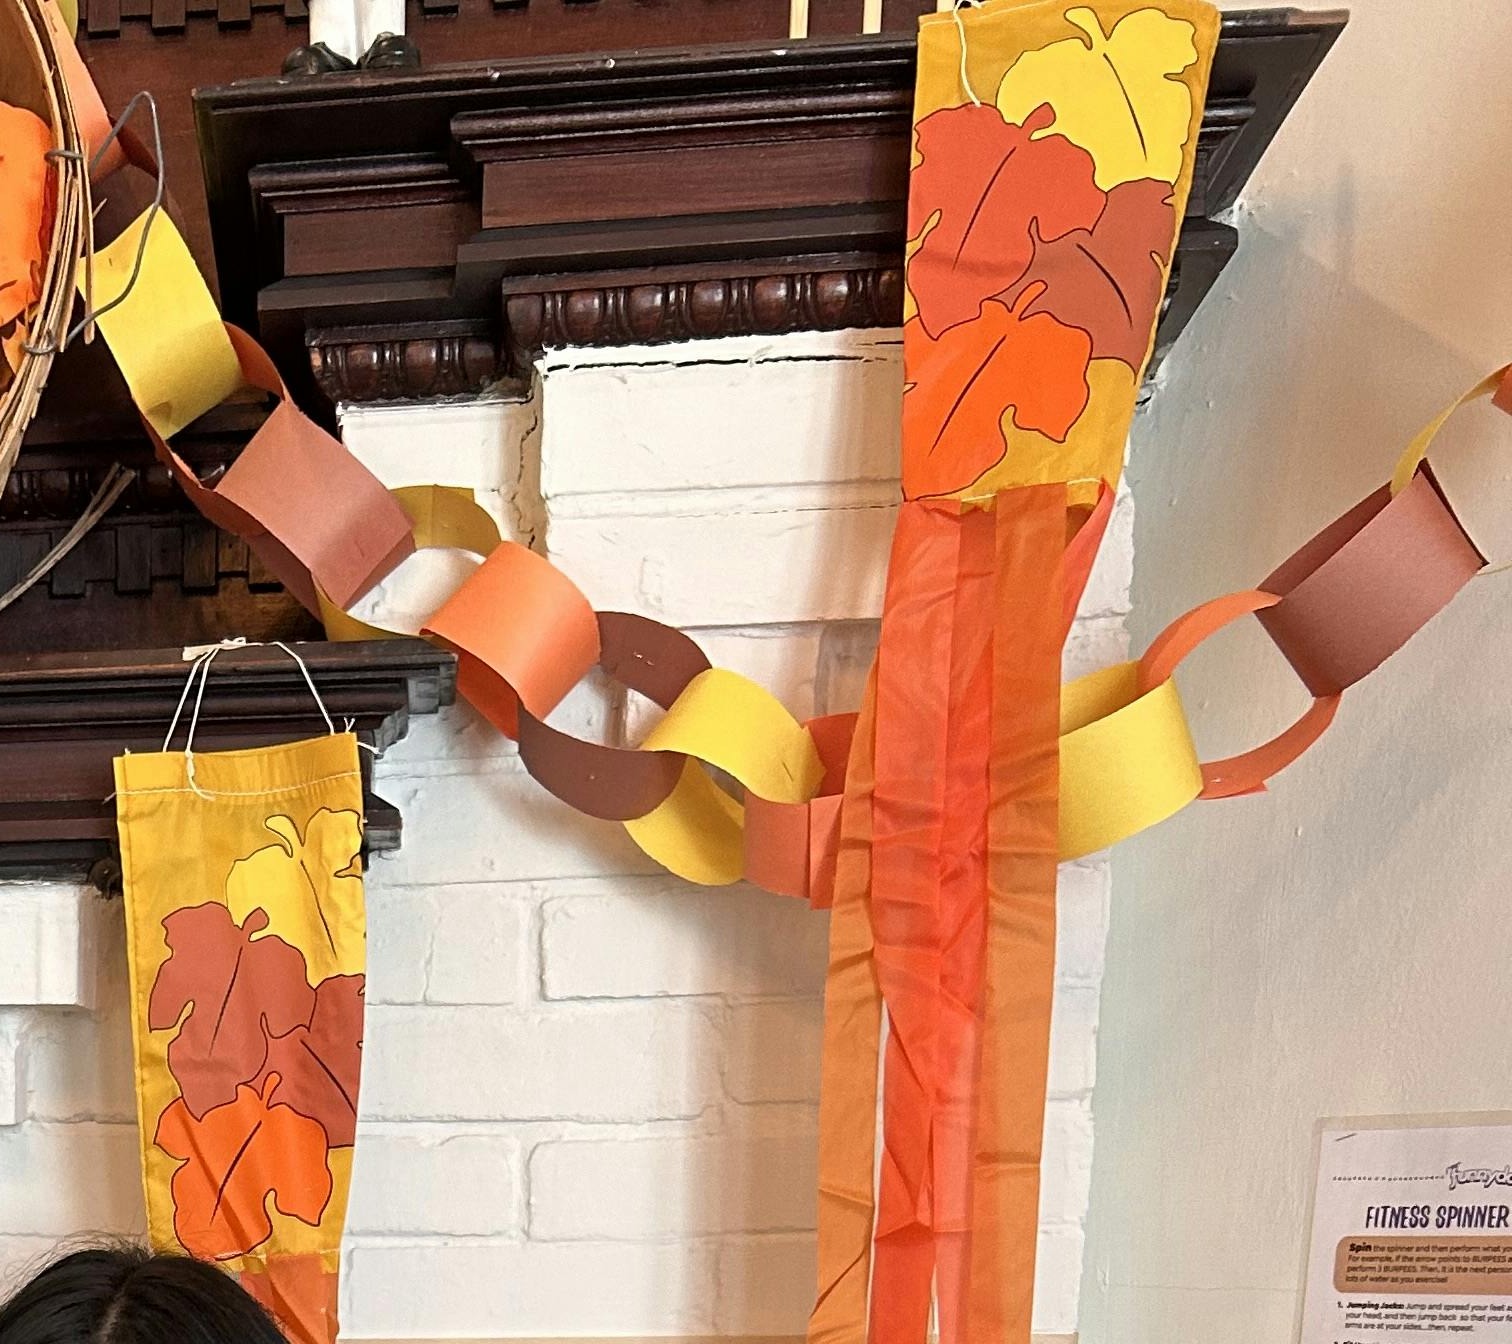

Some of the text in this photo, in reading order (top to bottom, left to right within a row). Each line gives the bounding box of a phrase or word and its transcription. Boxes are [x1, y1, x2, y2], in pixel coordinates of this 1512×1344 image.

[1365, 1205, 1510, 1229] FITNESS SPINNER
[1349, 1242, 1372, 1253] Spin
